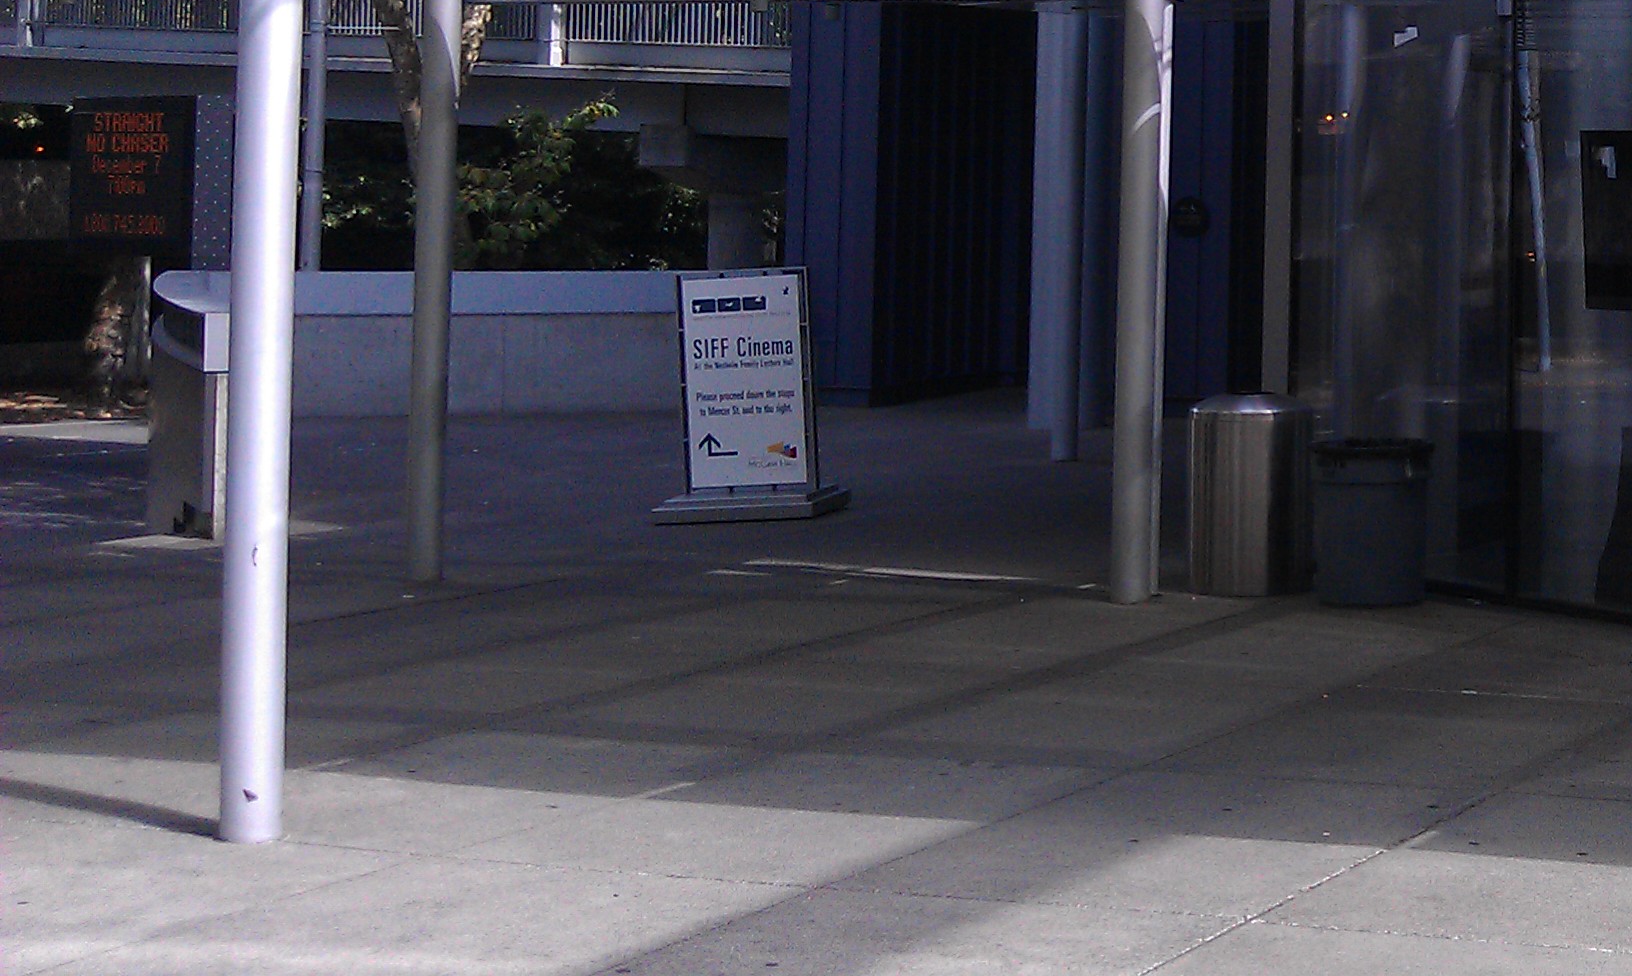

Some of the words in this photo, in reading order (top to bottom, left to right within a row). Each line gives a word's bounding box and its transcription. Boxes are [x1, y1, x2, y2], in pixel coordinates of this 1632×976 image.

[93, 112, 165, 132] STRAIGHT
[86, 133, 106, 152] NO
[112, 133, 169, 152] CHASER
[692, 337, 729, 360] SIFF
[736, 336, 793, 358] Cinema
[696, 391, 717, 402] Please
[766, 389, 776, 399] the
[700, 407, 706, 417] to
[755, 405, 762, 415] to
[764, 404, 774, 414] the
